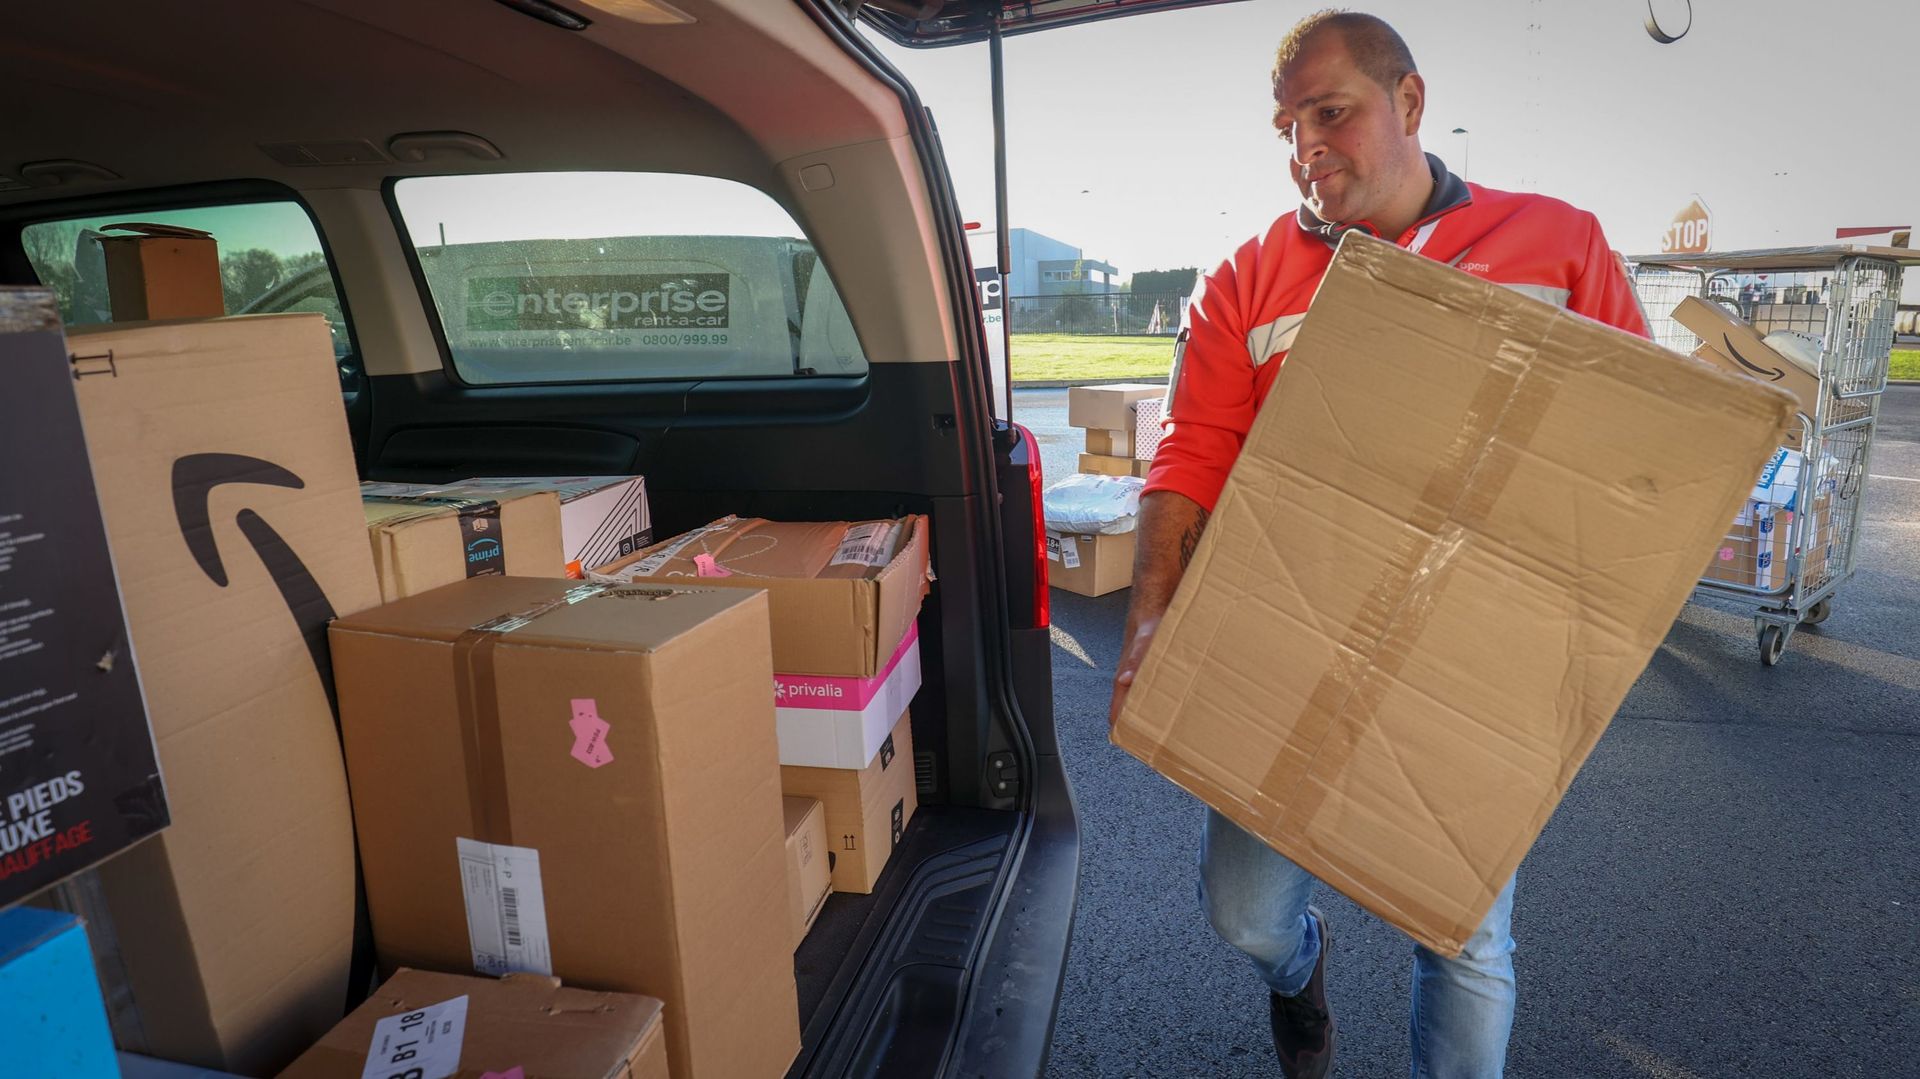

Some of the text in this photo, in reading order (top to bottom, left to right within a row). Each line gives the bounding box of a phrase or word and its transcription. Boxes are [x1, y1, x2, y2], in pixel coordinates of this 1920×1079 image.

[1662, 219, 1708, 252] STOP
[481, 285, 727, 321] enterprise
[635, 314, 726, 326] rent-a-car
[469, 333, 728, 349] www.nterpriserentcar.be 0800/999.99
[469, 544, 499, 562] prime
[788, 682, 843, 698] privalia
[7, 770, 85, 821] PIEDS
[400, 1011, 425, 1032] 18
